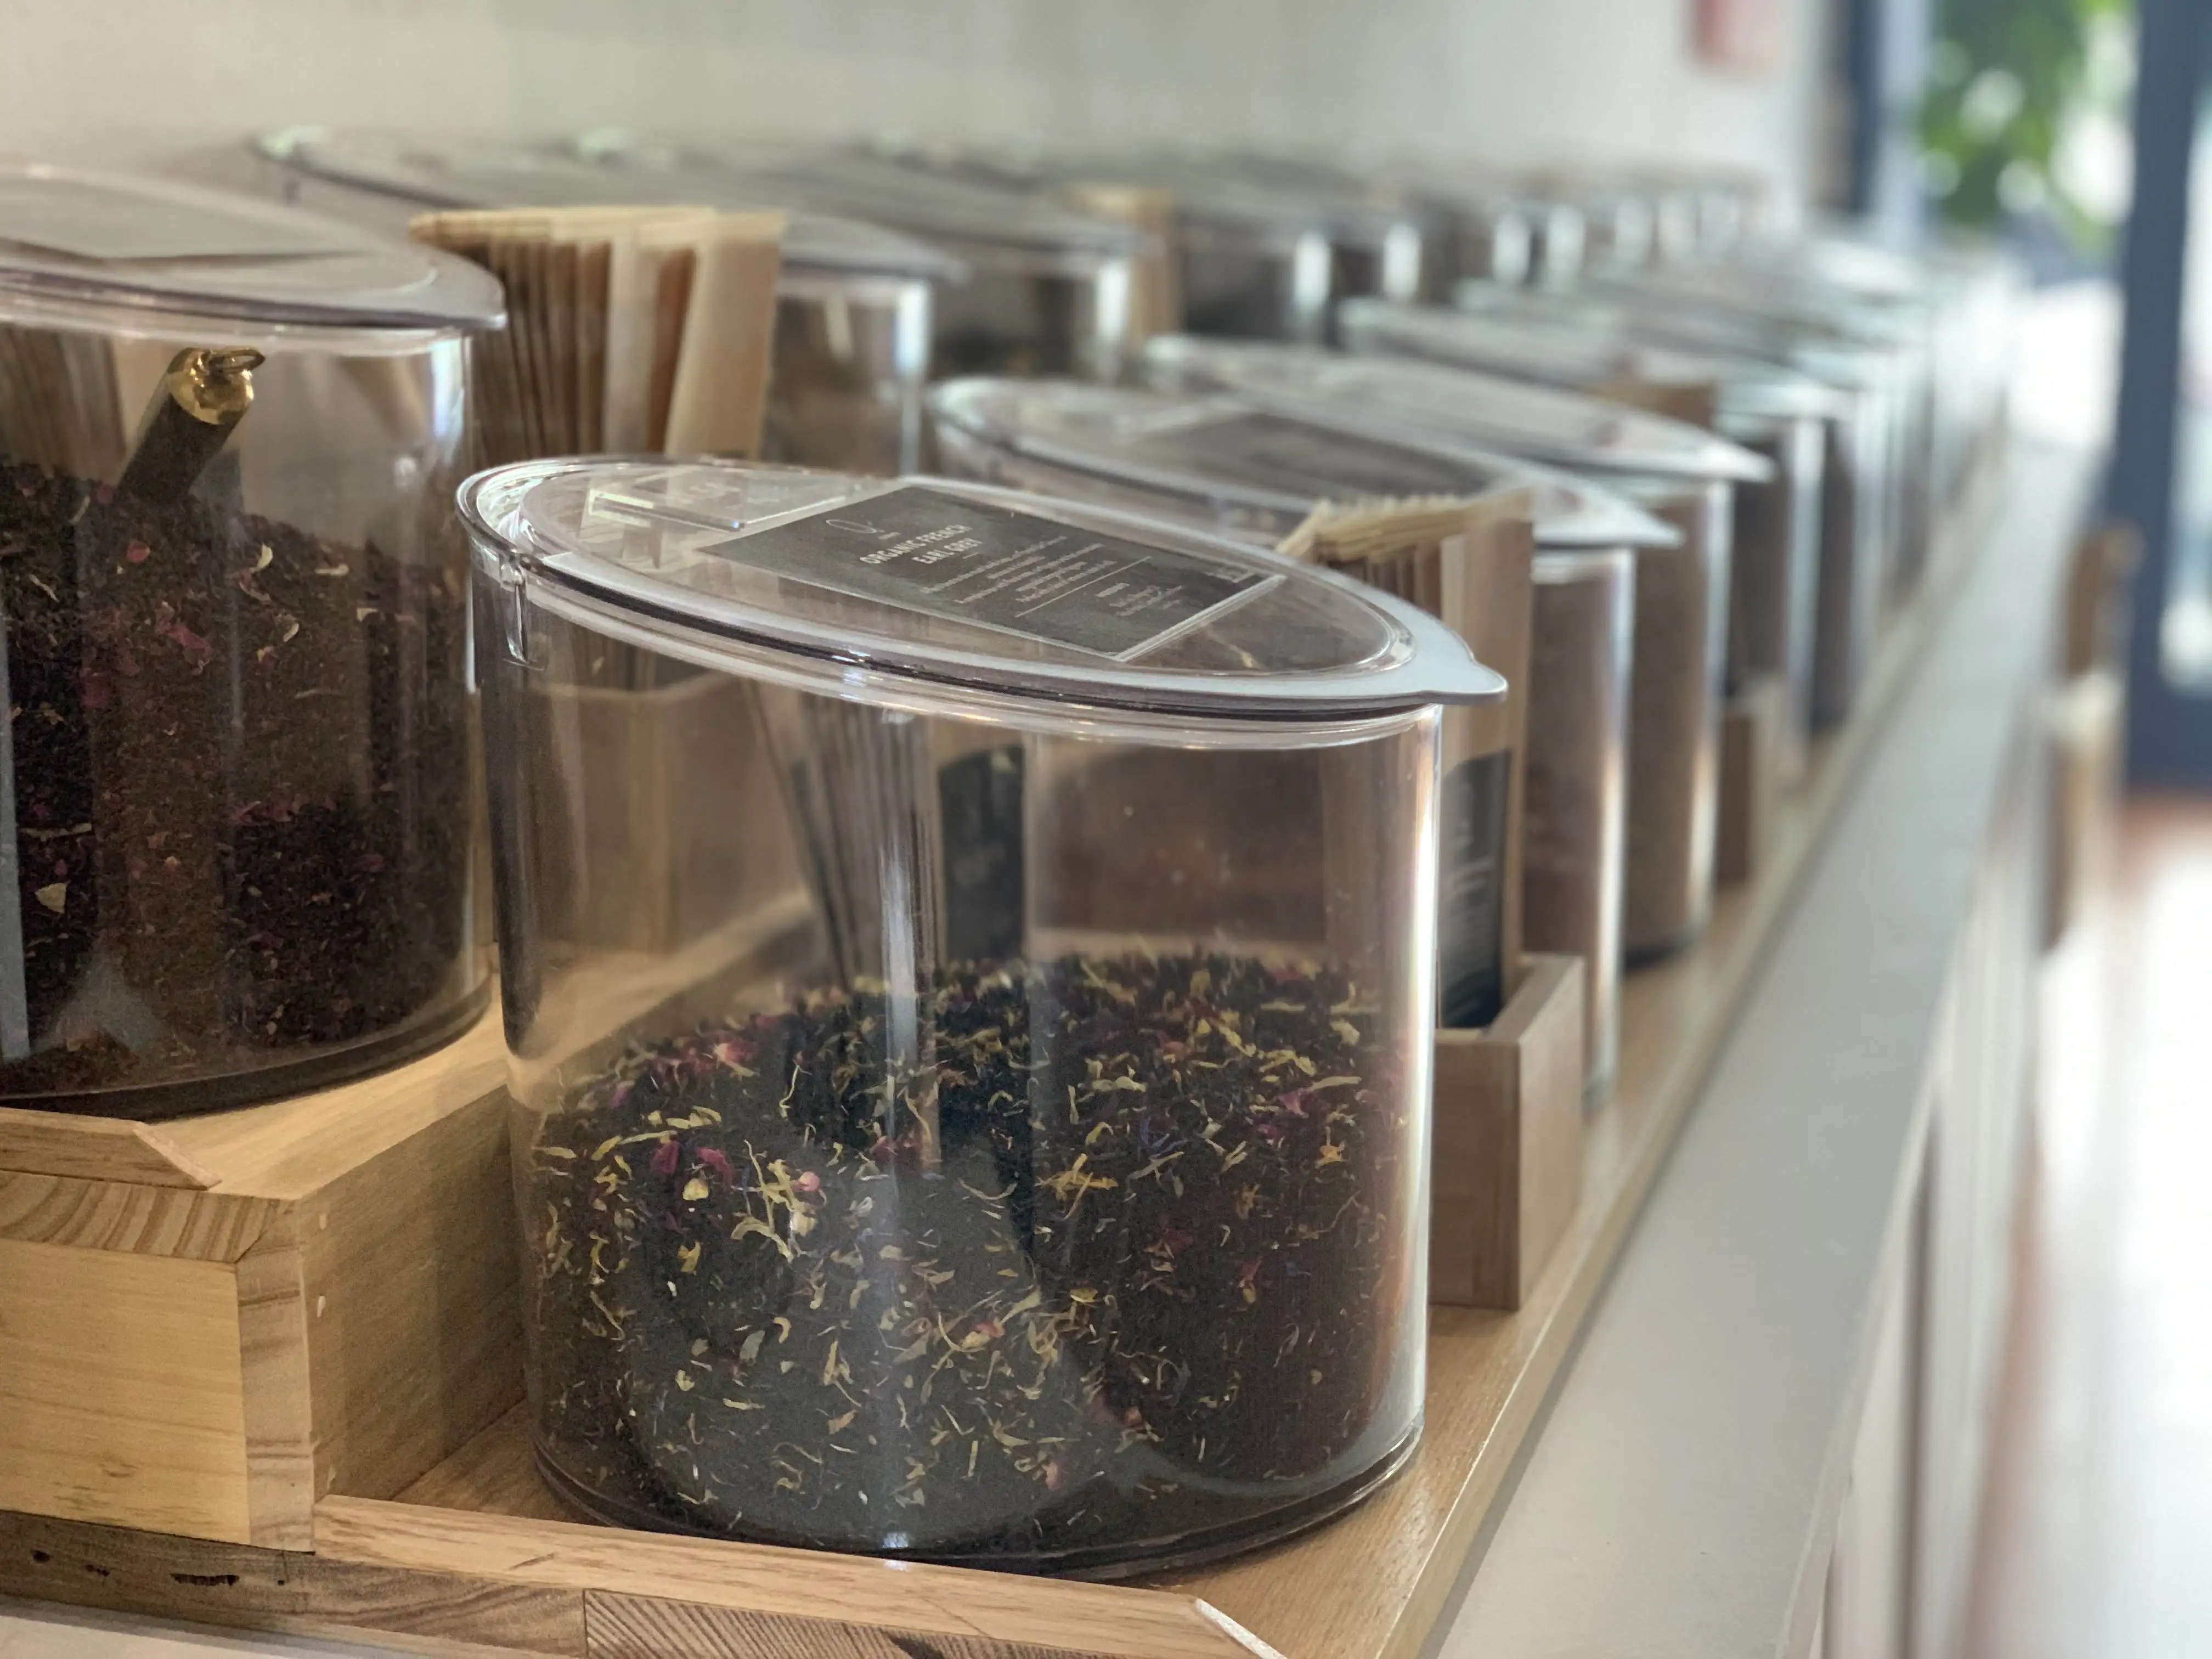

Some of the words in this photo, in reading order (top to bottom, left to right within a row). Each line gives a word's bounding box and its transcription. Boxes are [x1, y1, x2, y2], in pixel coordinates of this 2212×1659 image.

[860, 540, 926, 564] ORGANIC
[916, 524, 973, 543] FRENCH
[911, 549, 955, 564] EARL
[944, 538, 983, 551] GREY
